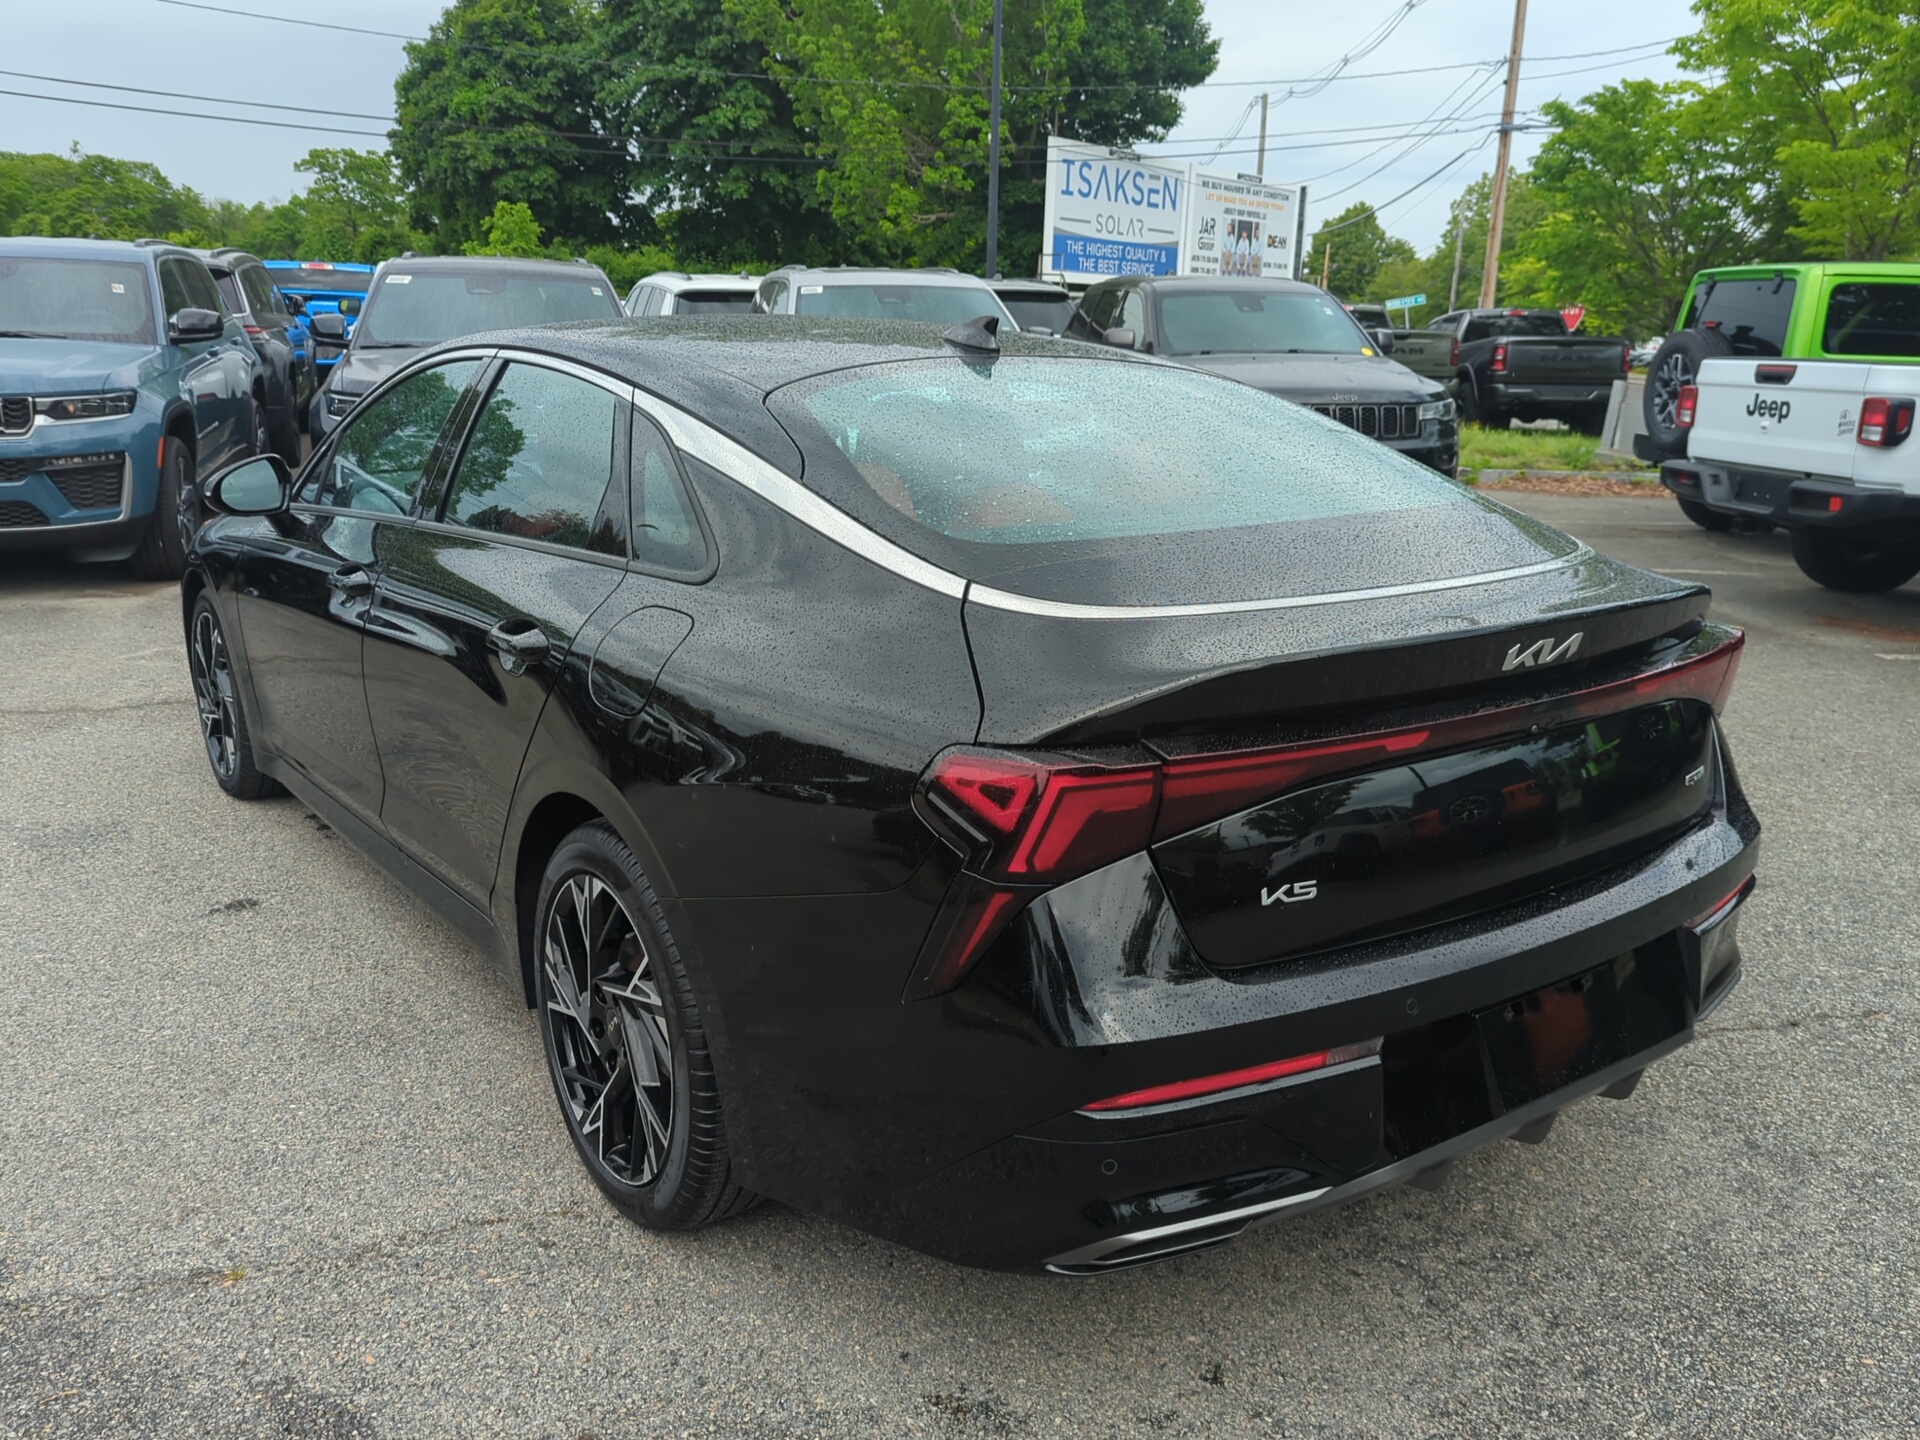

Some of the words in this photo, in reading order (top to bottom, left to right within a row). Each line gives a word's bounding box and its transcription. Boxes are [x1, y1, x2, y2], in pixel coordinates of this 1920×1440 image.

[1061, 158, 1179, 212] ISAKSEN
[1201, 180, 1210, 188] WE
[1211, 181, 1222, 190] BUY
[1223, 184, 1245, 194] HOUSES
[1245, 186, 1251, 195] IN
[1252, 188, 1262, 197] ANY
[1263, 190, 1289, 201] CONDITION
[1206, 193, 1214, 201] LET
[1095, 213, 1144, 238] SOLAR
[1199, 216, 1216, 236] JAR
[1066, 240, 1084, 254] THE
[1086, 242, 1124, 258] HIGHEST
[1125, 246, 1159, 262] QUALITY
[1160, 250, 1167, 263] &
[1078, 257, 1096, 272] THE
[1097, 259, 1120, 274] BEST
[1121, 261, 1155, 277] SERVICE
[1391, 345, 1424, 355] AM
[1331, 392, 1358, 402] Jeep
[1746, 393, 1791, 424] Jeep
[1501, 632, 1584, 671] KIA
[1261, 879, 1318, 906] K5
